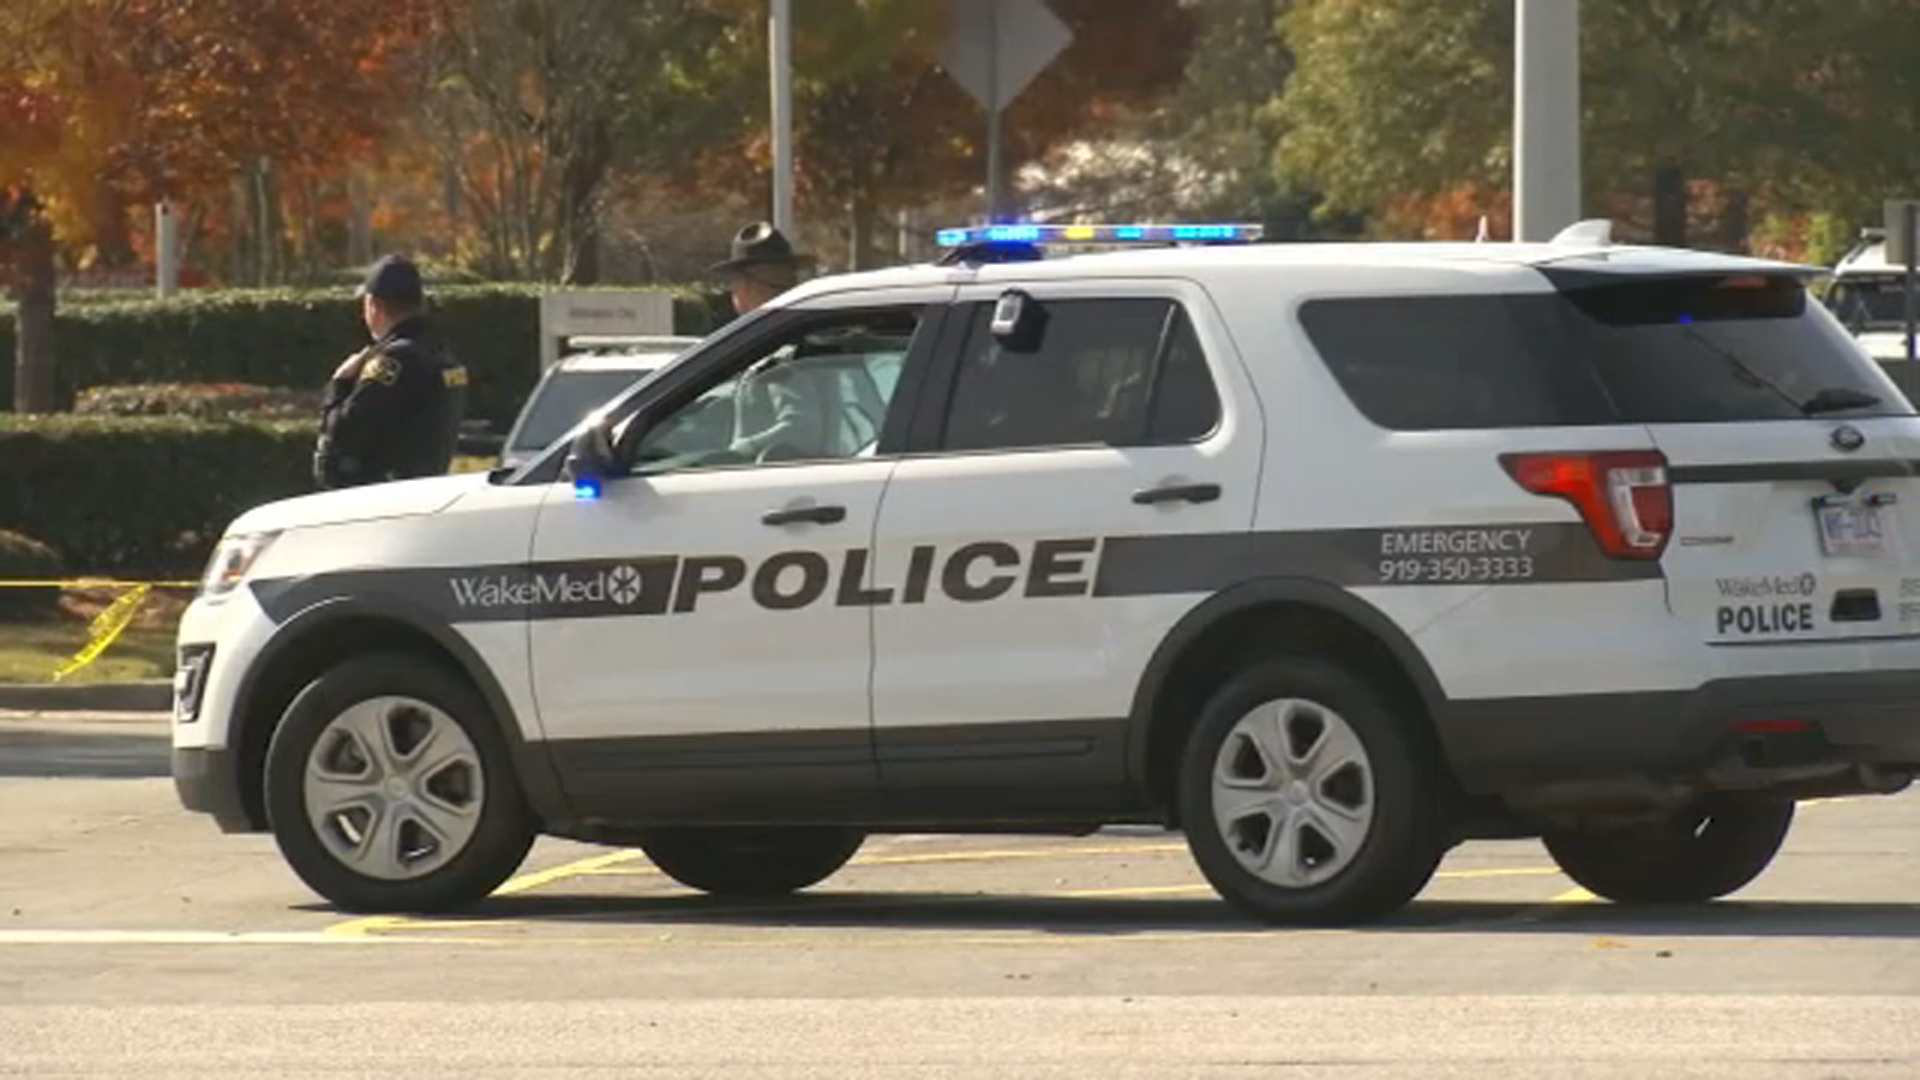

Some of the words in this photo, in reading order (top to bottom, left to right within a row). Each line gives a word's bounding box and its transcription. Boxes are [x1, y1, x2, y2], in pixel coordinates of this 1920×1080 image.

[1381, 529, 1532, 554] EMERGENCY
[672, 537, 1097, 613] POLICE
[1378, 556, 1534, 582] 919-350-3333
[449, 571, 605, 607] WakeMed
[1716, 603, 1814, 634] POLICE
